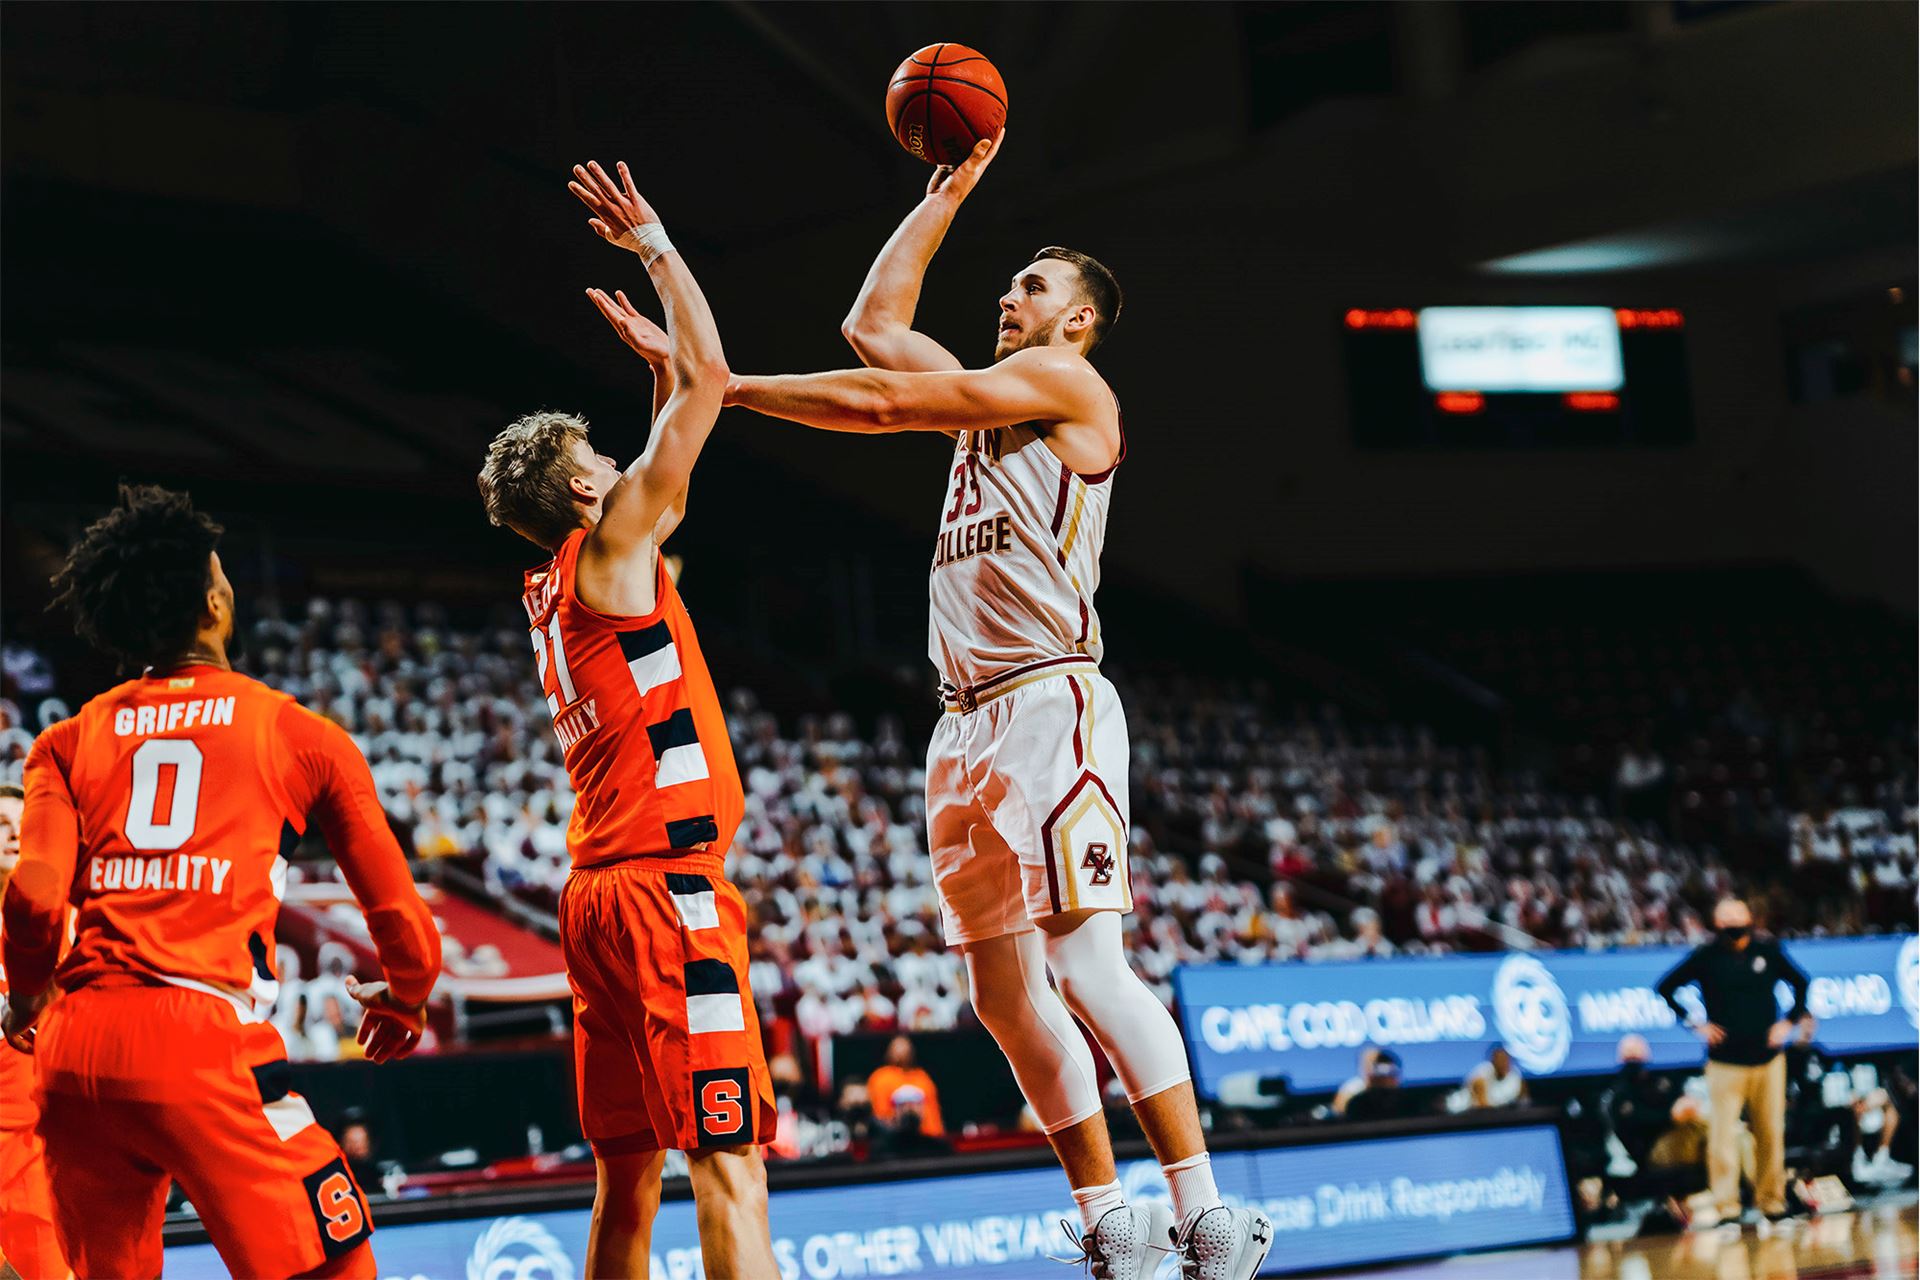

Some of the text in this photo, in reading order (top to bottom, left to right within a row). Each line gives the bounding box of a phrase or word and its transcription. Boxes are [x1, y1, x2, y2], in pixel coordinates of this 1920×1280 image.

[946, 453, 982, 523] 33
[932, 514, 1011, 572] OLLEGE
[529, 609, 578, 720] 21
[114, 696, 235, 736] GRIFFIN
[124, 738, 204, 850] 0
[89, 854, 232, 894] EQUALITY
[1287, 1000, 1368, 1049] COD
[702, 1079, 743, 1135] S
[317, 1172, 363, 1242] S
[1315, 1184, 1392, 1228] Drink
[803, 1225, 921, 1280] OTHER
